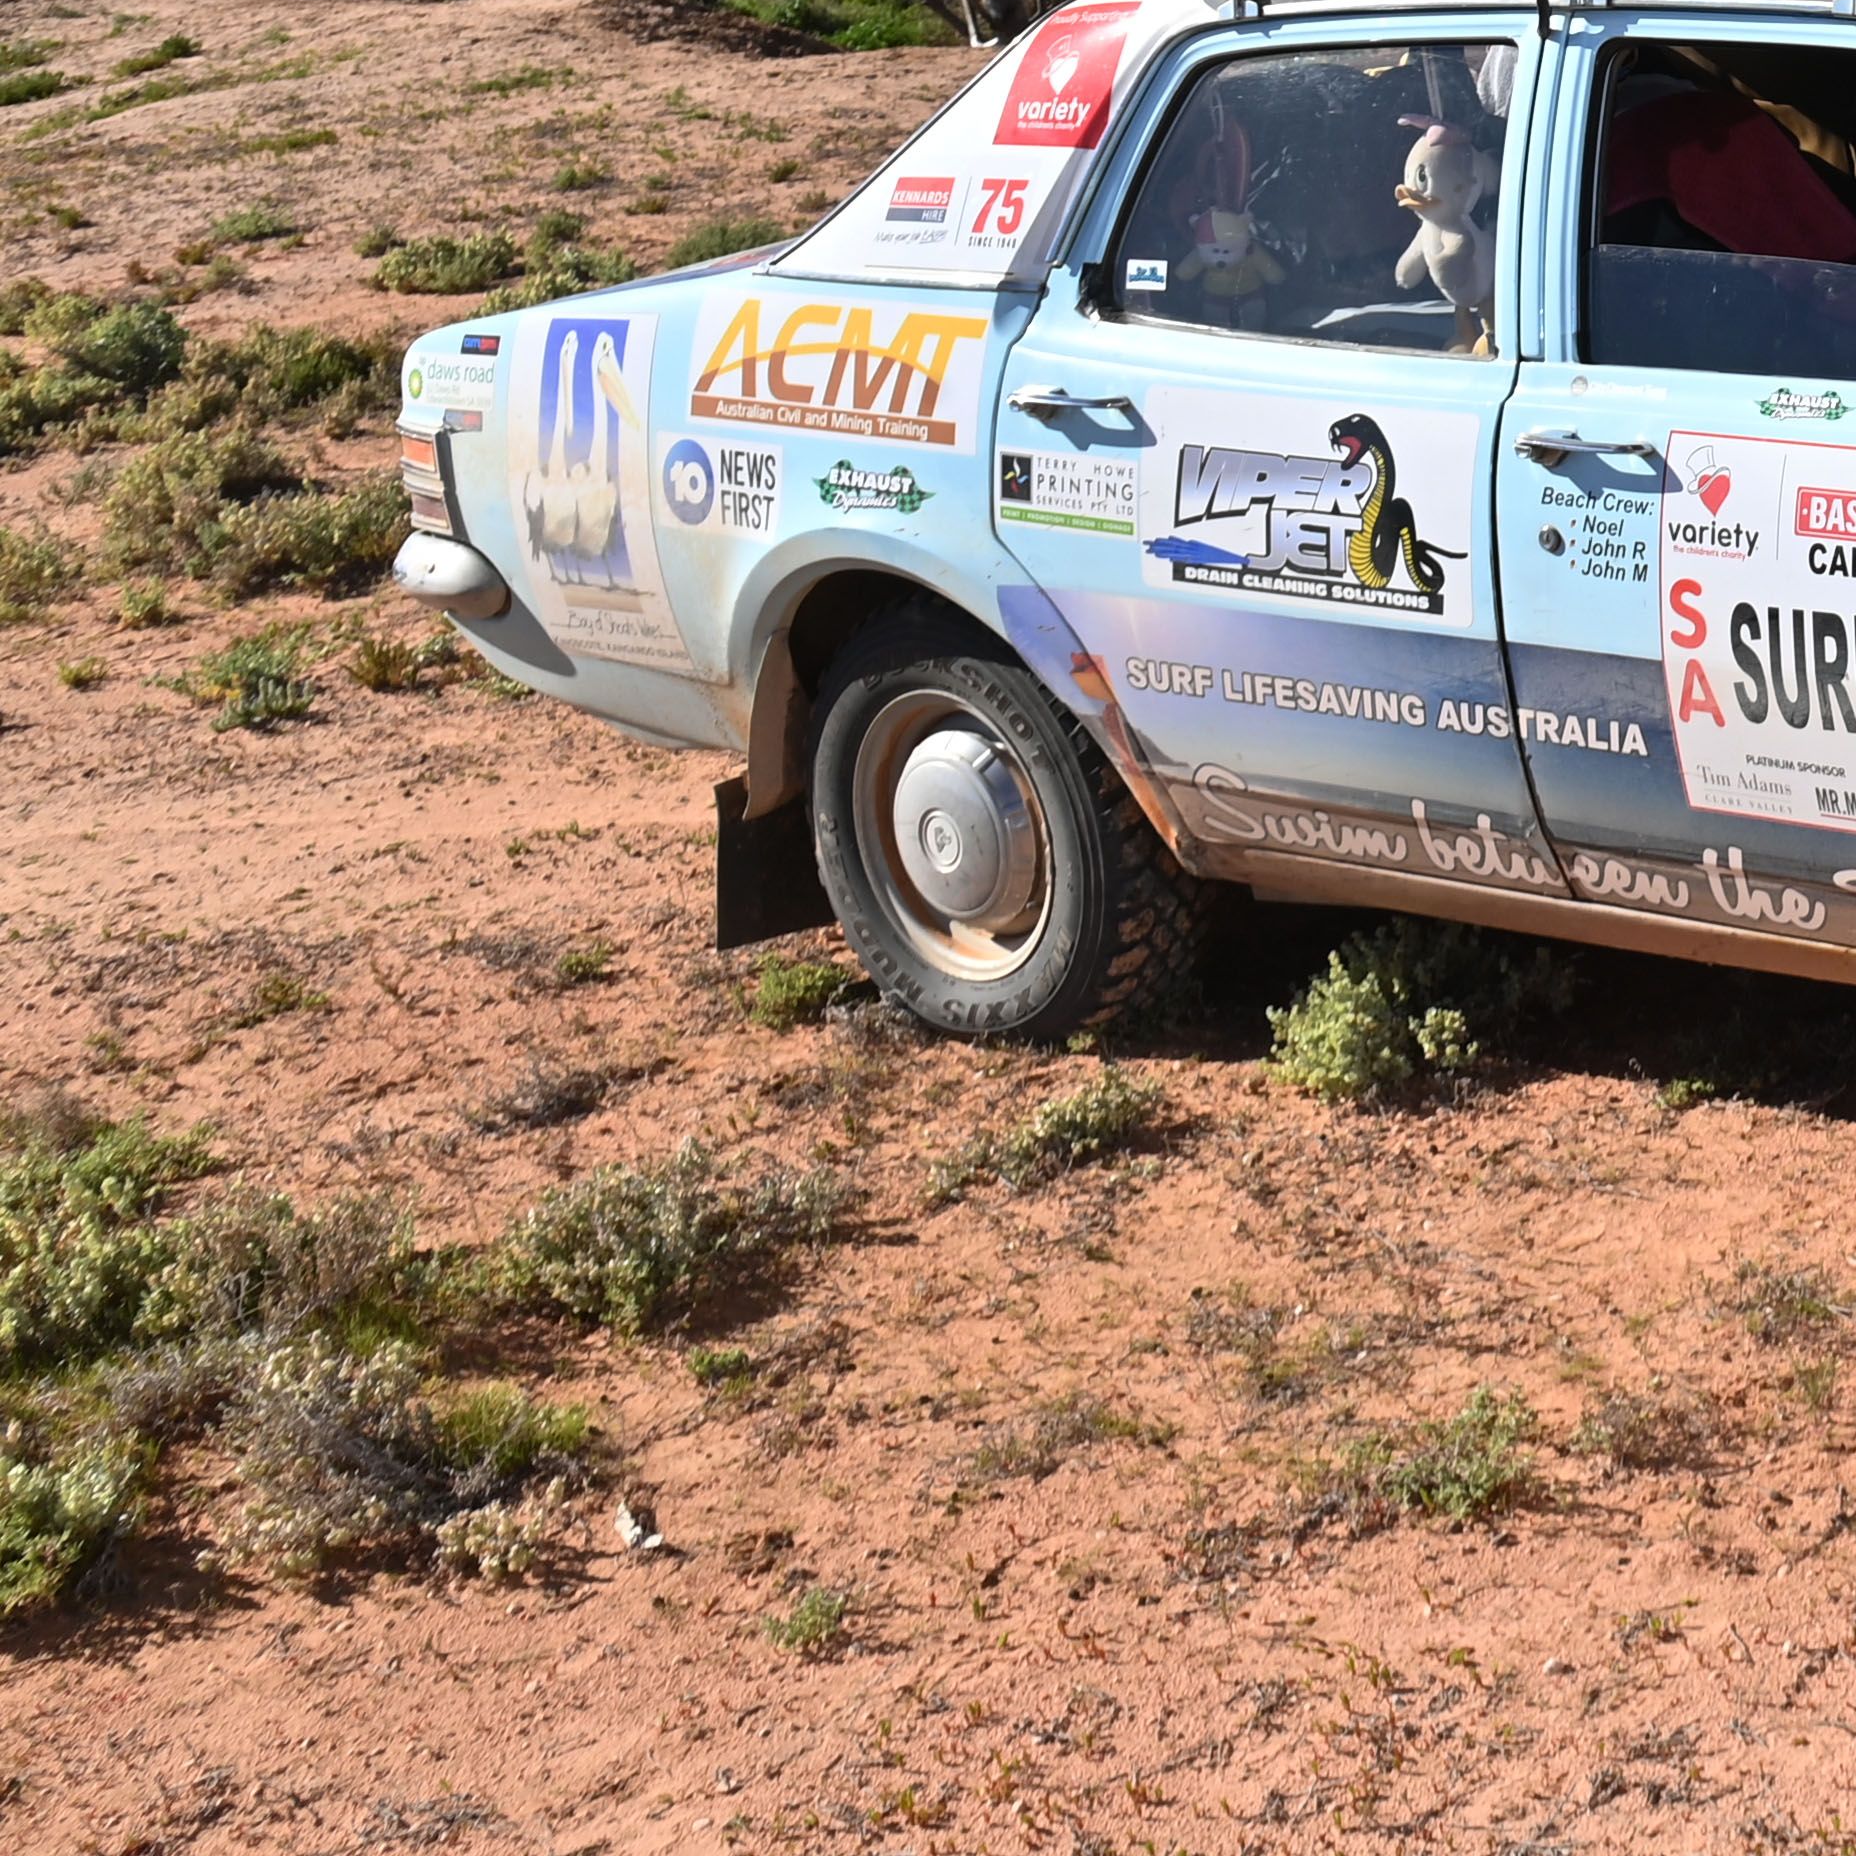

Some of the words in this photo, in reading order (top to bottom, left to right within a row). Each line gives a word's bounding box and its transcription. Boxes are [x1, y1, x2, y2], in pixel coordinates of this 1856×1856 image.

[1017, 98, 1092, 127] variety
[891, 190, 950, 204] KENNARDS
[971, 178, 1029, 235] 75
[921, 210, 944, 222] HIRE
[968, 236, 992, 248] SINCE
[427, 359, 461, 382] daws
[464, 362, 495, 383] road
[694, 299, 988, 417] ACMT
[1769, 392, 1841, 409] EXHAUST
[716, 399, 774, 421] Australian
[777, 406, 800, 423] Civil
[805, 410, 826, 426] and
[831, 414, 872, 435] Mining
[877, 420, 928, 441] Training
[670, 460, 708, 505] 10
[720, 448, 776, 490] NEWS
[829, 468, 912, 494] EXHAUST
[1038, 457, 1077, 470] TERRY
[1093, 464, 1134, 479] HOWE
[1037, 474, 1133, 501] PRINTING
[1175, 444, 1372, 527] VIPER
[721, 489, 775, 532] FIRST
[832, 490, 897, 514] Dynamics
[1036, 495, 1083, 509] SERVICES
[1091, 501, 1108, 512] PTY
[1116, 507, 1134, 516] LTD
[1541, 486, 1597, 510] Beach
[1604, 492, 1655, 516] Crew:
[1582, 515, 1624, 537] Noel
[1668, 520, 1756, 556] variety
[1246, 510, 1363, 574] JET
[1581, 540, 1626, 560] John
[1633, 542, 1646, 559] R
[1673, 545, 1687, 554] the
[1688, 545, 1719, 558] children's
[1721, 551, 1746, 561] charity
[1581, 561, 1626, 582] John
[1633, 564, 1648, 582] M
[1184, 566, 1238, 586] DRAIN
[1242, 573, 1328, 598] CLEANING
[1332, 582, 1430, 610] SOLUTIONS
[1669, 578, 1707, 649] S
[1125, 656, 1213, 697] SURF
[1222, 669, 1426, 727] LIFESAVING
[1435, 698, 1648, 757] AUSTRALIA
[1678, 657, 1726, 728] A
[1696, 764, 1731, 786] Tim
[1737, 772, 1792, 795] Adams
[1745, 754, 1795, 770] PLATINUM
[1797, 762, 1846, 778] SPONSOR
[1705, 794, 1742, 806] CLARE
[1750, 800, 1793, 814] VALLEY
[1176, 762, 1407, 862] Swim
[1411, 798, 1689, 910] between
[1699, 846, 1826, 932] the
